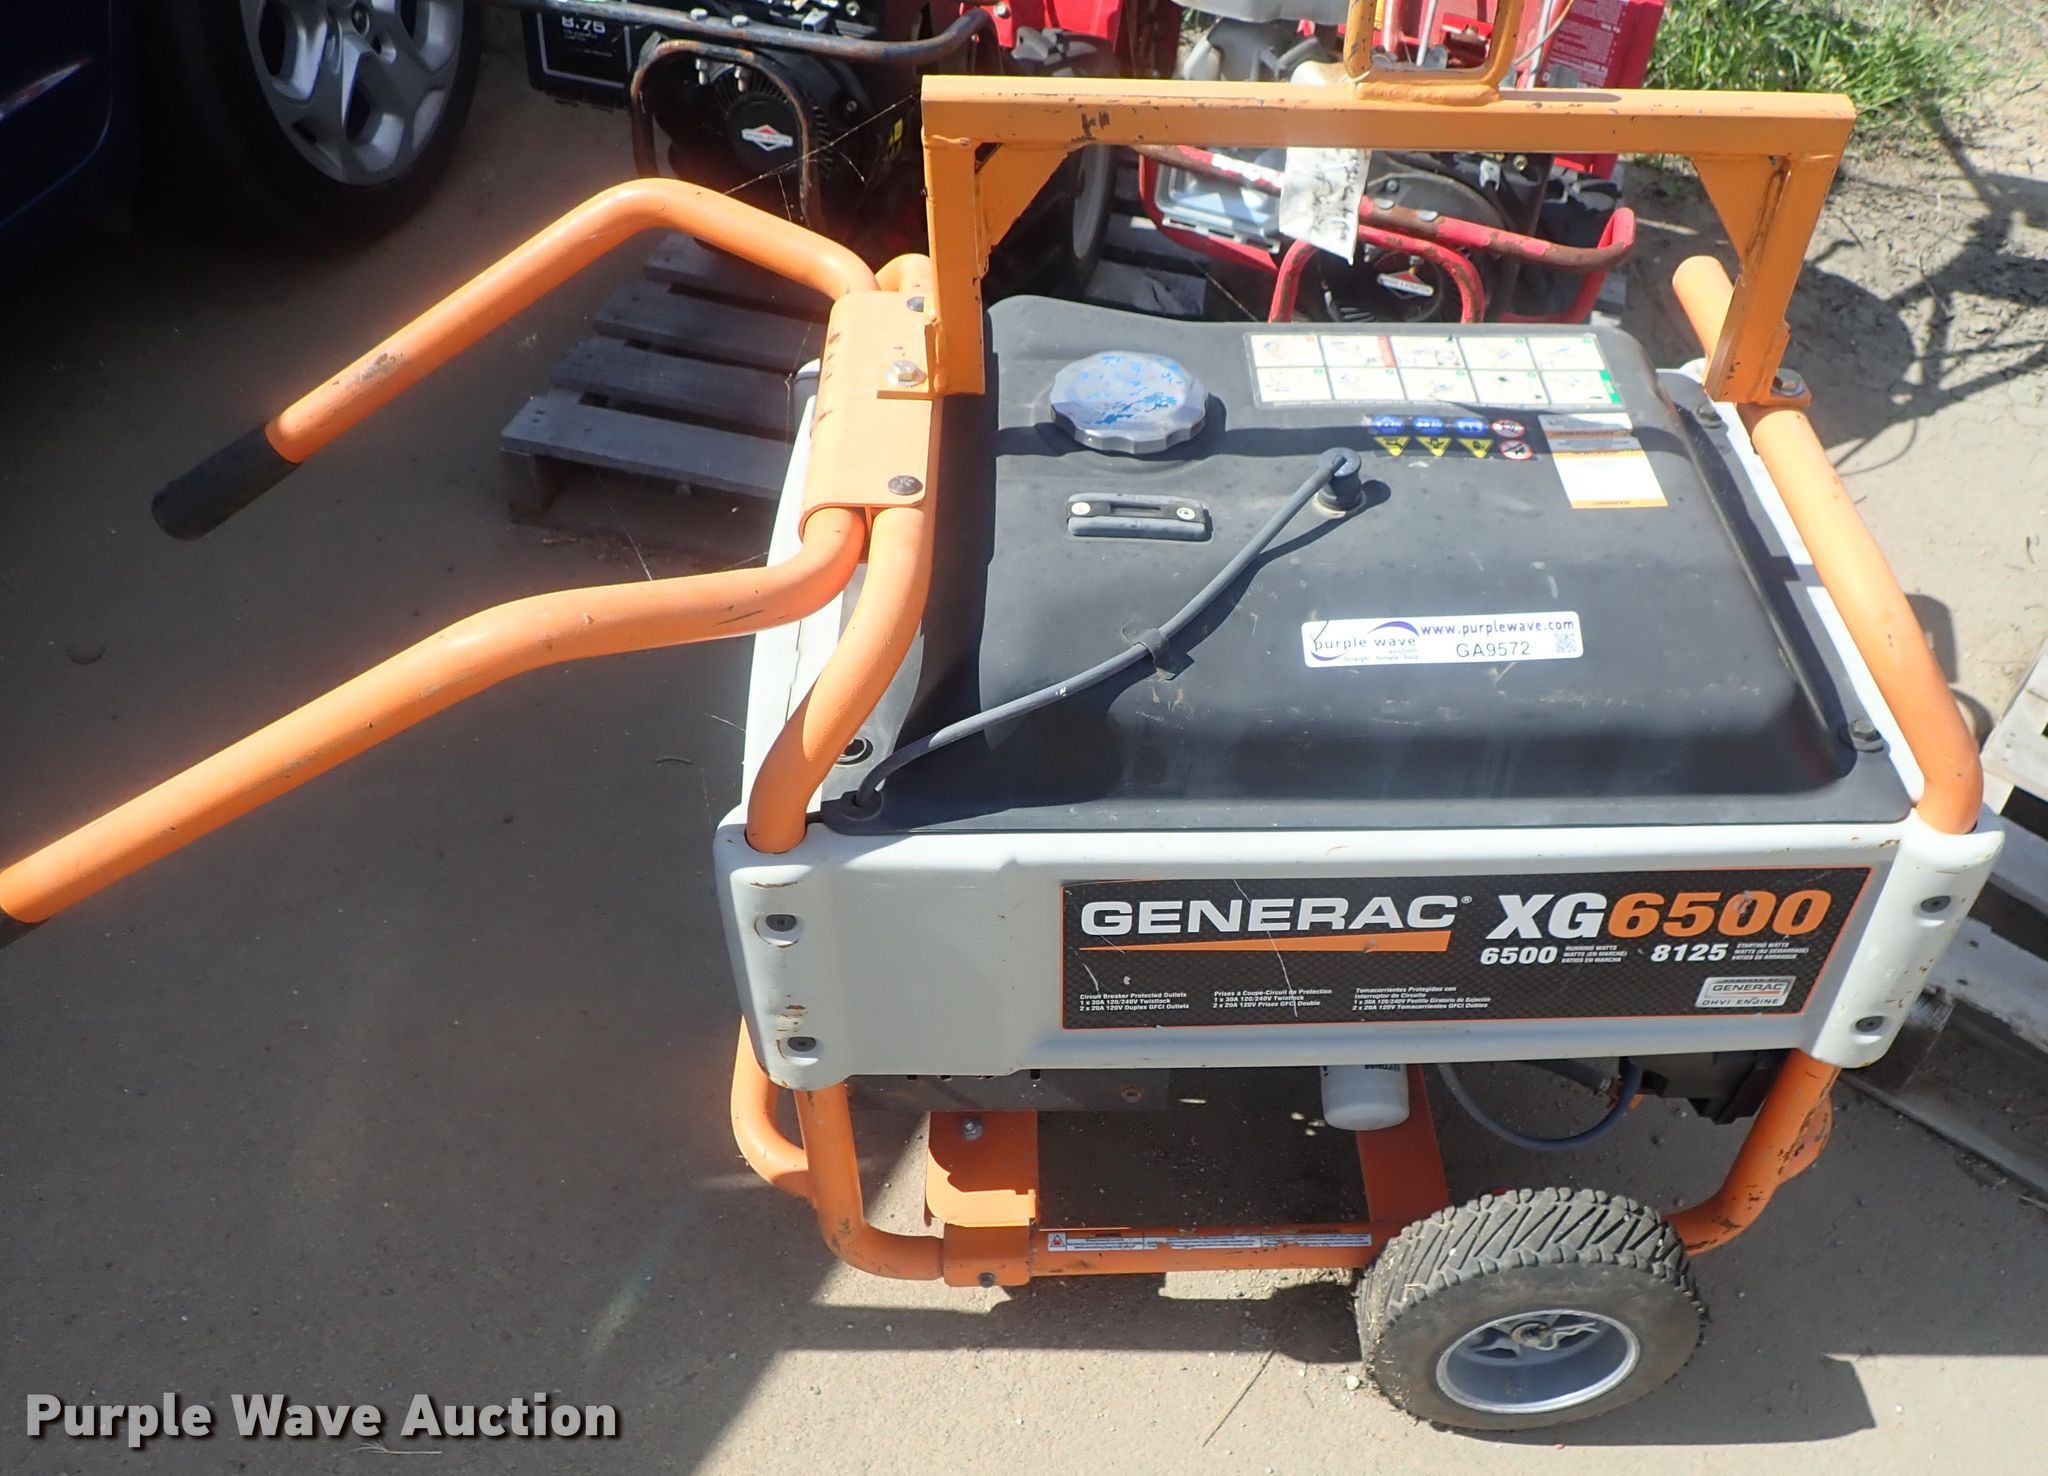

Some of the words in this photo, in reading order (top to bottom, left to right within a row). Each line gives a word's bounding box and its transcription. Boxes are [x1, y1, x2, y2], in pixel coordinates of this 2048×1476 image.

[1421, 620, 1574, 635] www.purplewave.com
[1314, 636, 1367, 652] purple
[1373, 637, 1416, 648] wave
[1456, 641, 1531, 658] GA9572
[1486, 889, 1832, 940] XG6500
[1480, 946, 1558, 965] 6500
[1650, 943, 1729, 962] 8125
[1712, 983, 1785, 992] GENERAC
